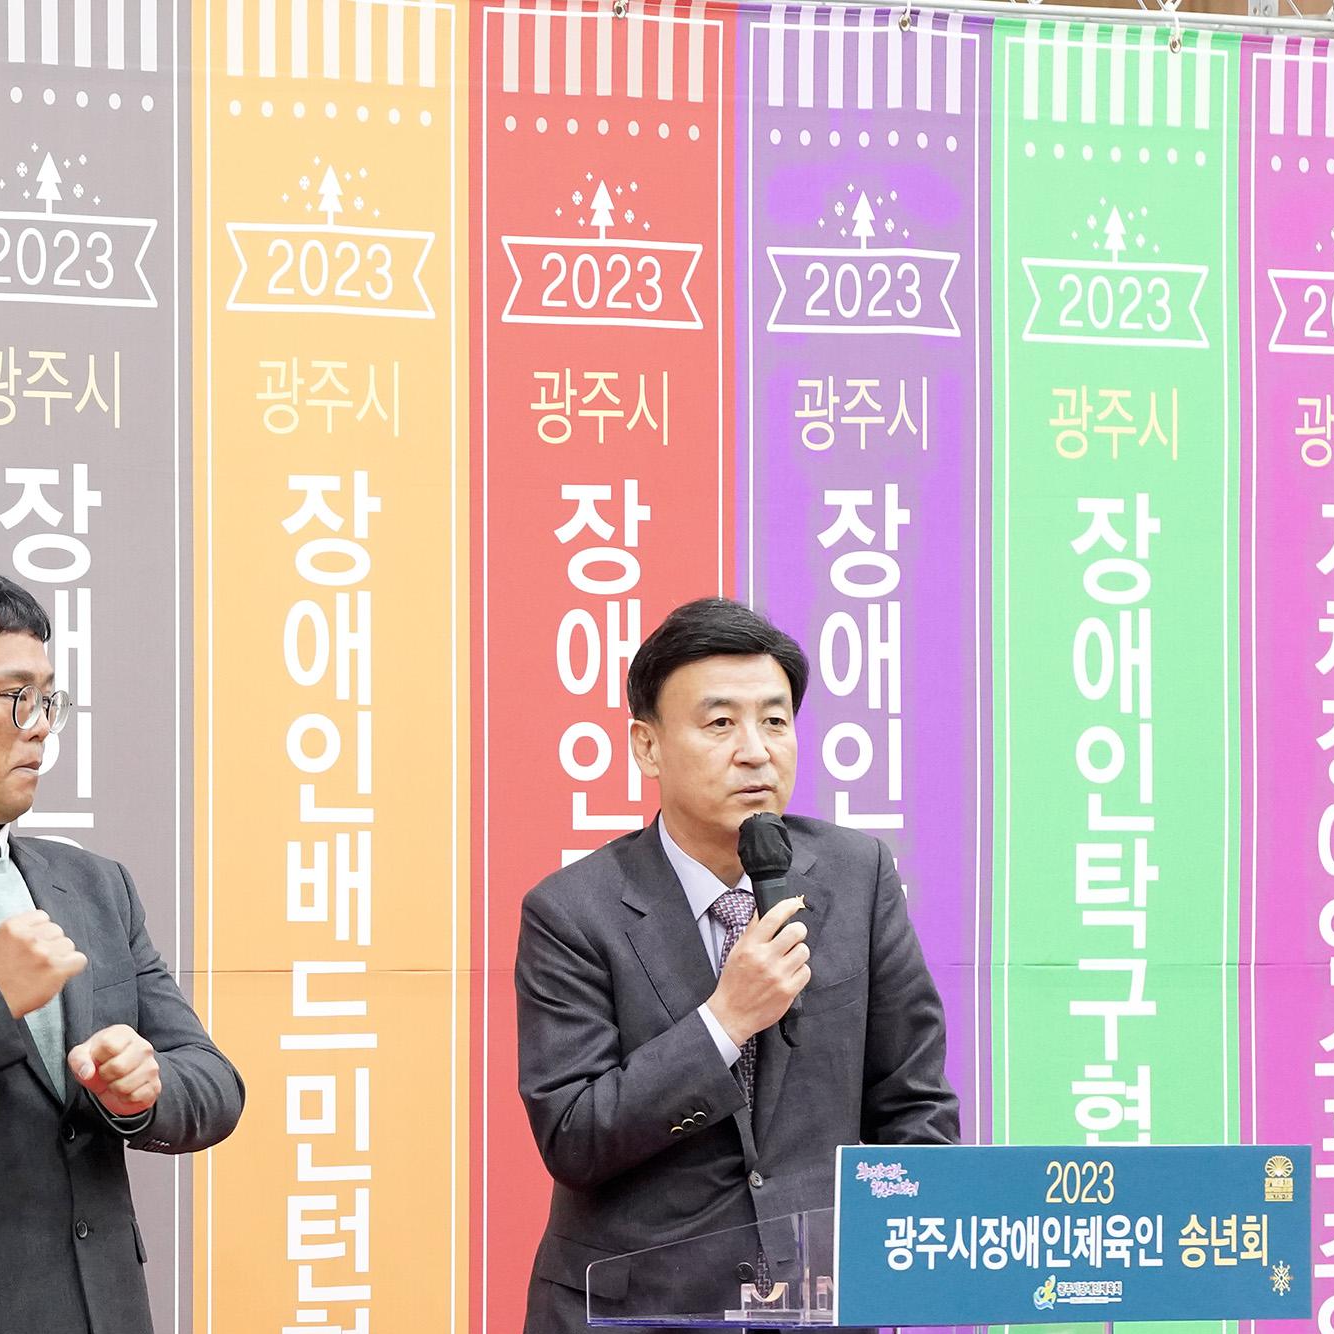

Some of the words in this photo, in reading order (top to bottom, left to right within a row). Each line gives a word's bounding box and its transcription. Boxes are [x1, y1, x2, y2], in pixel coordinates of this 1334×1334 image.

[268, 239, 393, 300] 2023
[542, 252, 662, 312] 2023
[805, 263, 922, 318] 2023
[1059, 274, 1171, 331] 2023
[257, 358, 398, 436] 광주시
[530, 368, 669, 446] 광주시
[794, 376, 928, 451] 광주시
[1049, 386, 1177, 460] 광주시
[555, 479, 651, 868] 장애인
[1045, 1160, 1115, 1204] 2023
[884, 1214, 1164, 1271] 광주시장애인체육인
[1178, 1213, 1270, 1268] 송년회
